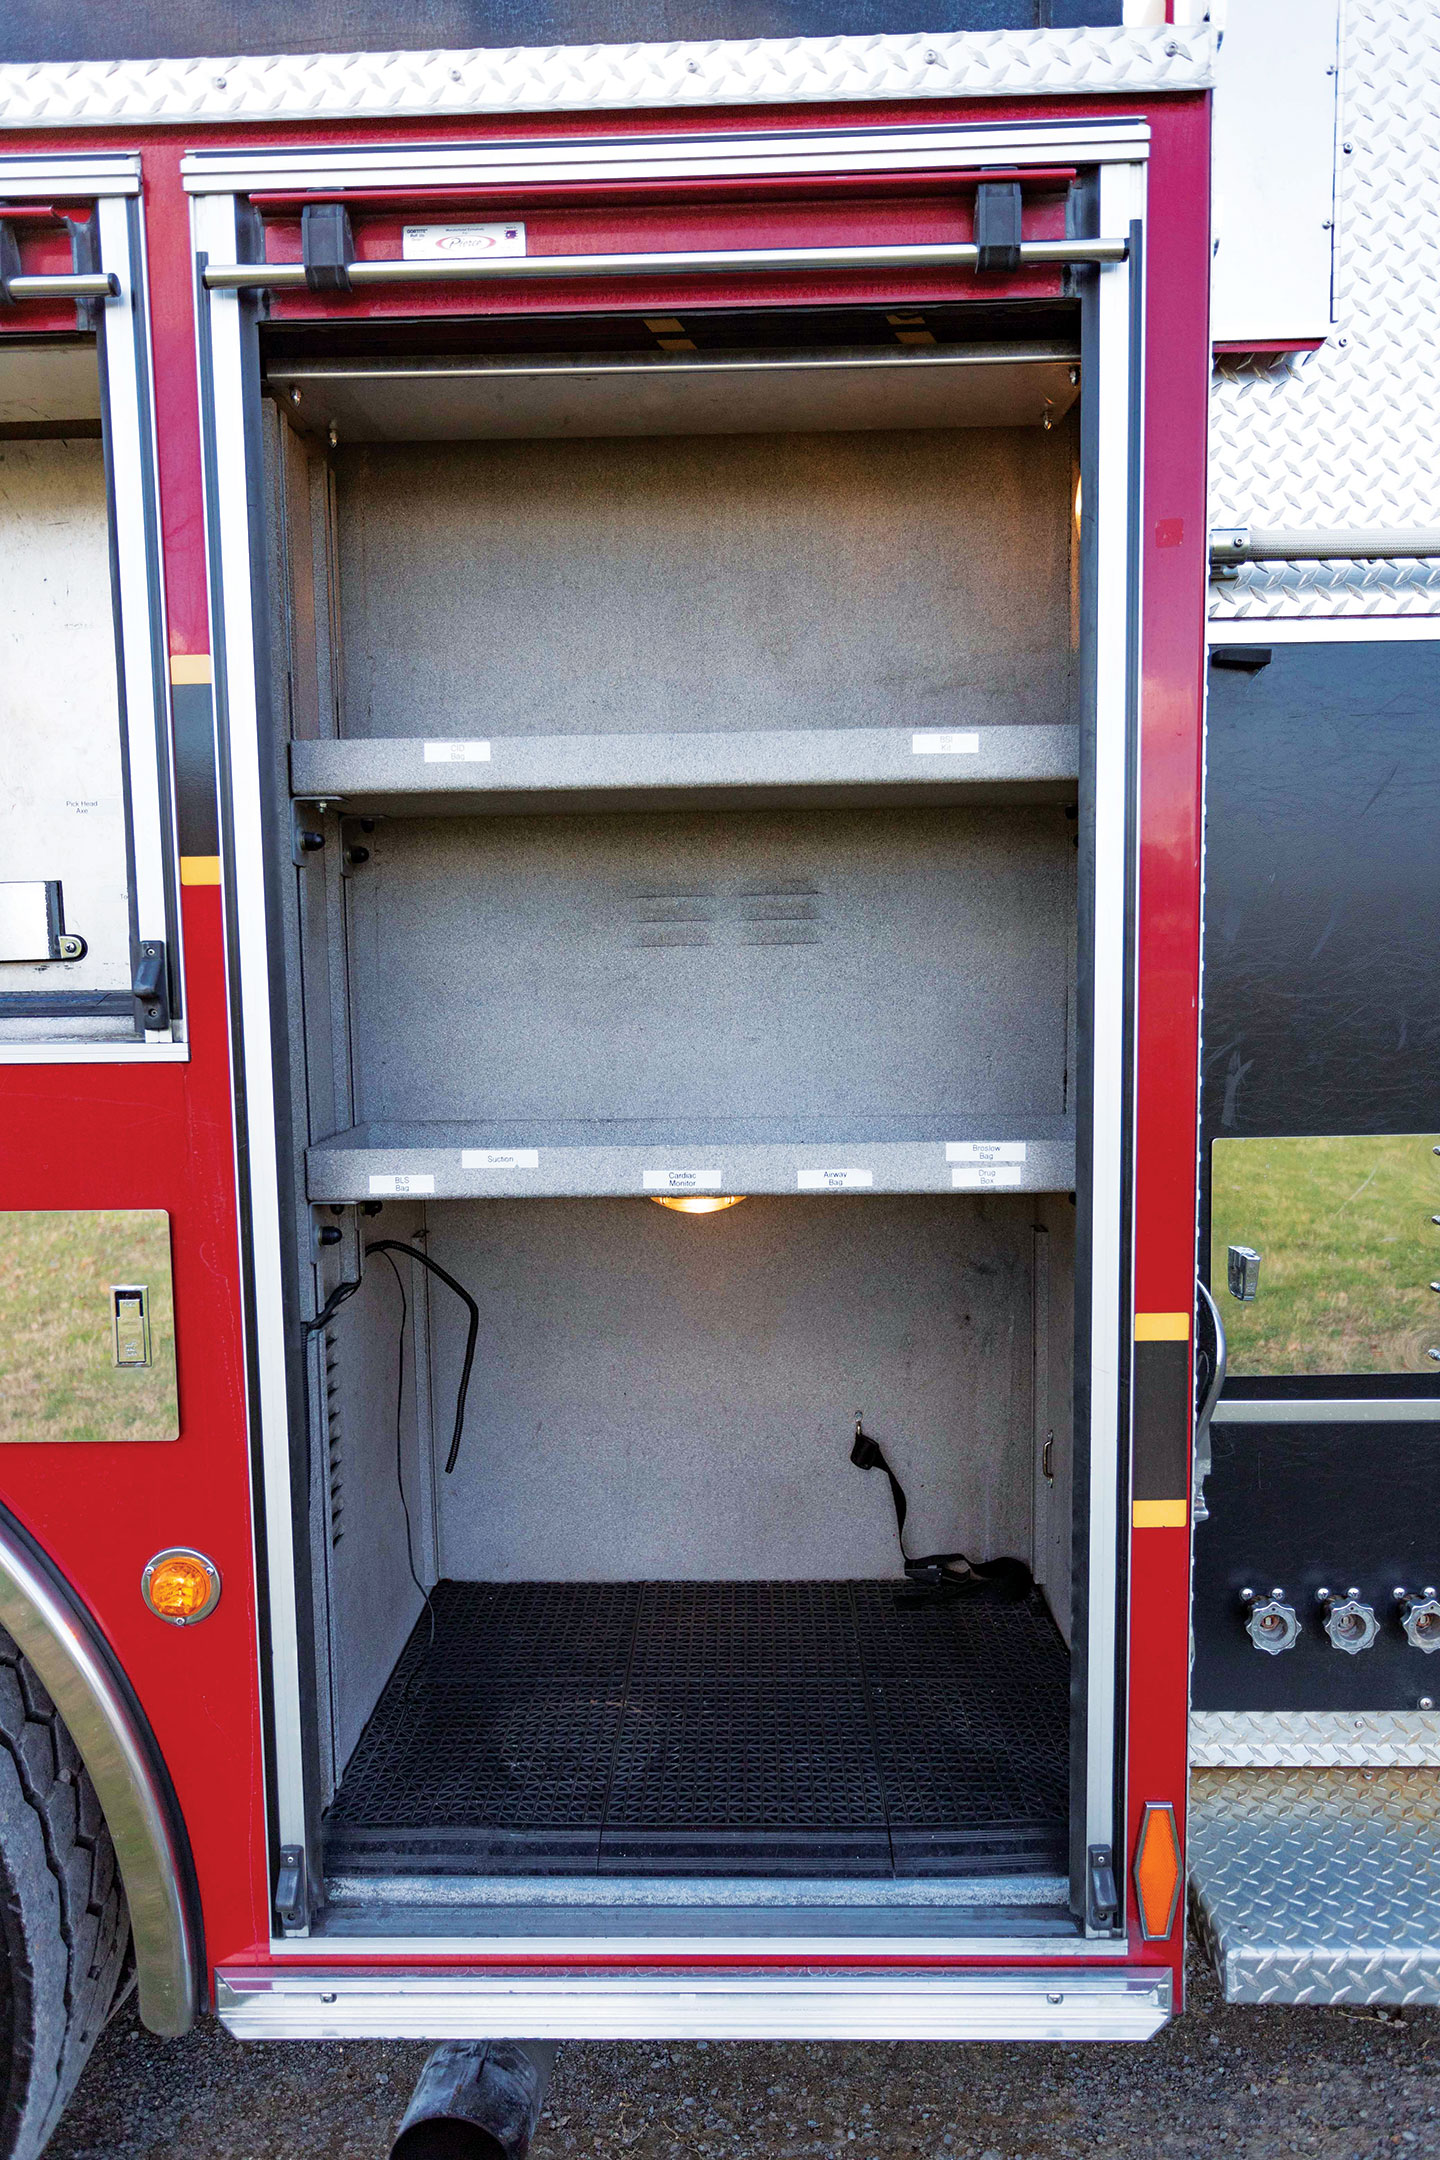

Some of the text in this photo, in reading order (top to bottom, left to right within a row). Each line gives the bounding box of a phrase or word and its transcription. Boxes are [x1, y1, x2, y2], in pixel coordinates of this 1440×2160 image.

[450, 744, 465, 752] CID
[450, 753, 465, 761] Bag
[972, 1144, 1001, 1152] Broslow
[487, 1155, 514, 1163] Suction
[668, 1171, 697, 1179] Cardiac
[823, 1171, 848, 1179] Airway
[978, 1169, 996, 1177] Drug
[828, 1179, 843, 1187] Bag
[980, 1177, 994, 1185] Box
[395, 1185, 410, 1193] Bag
